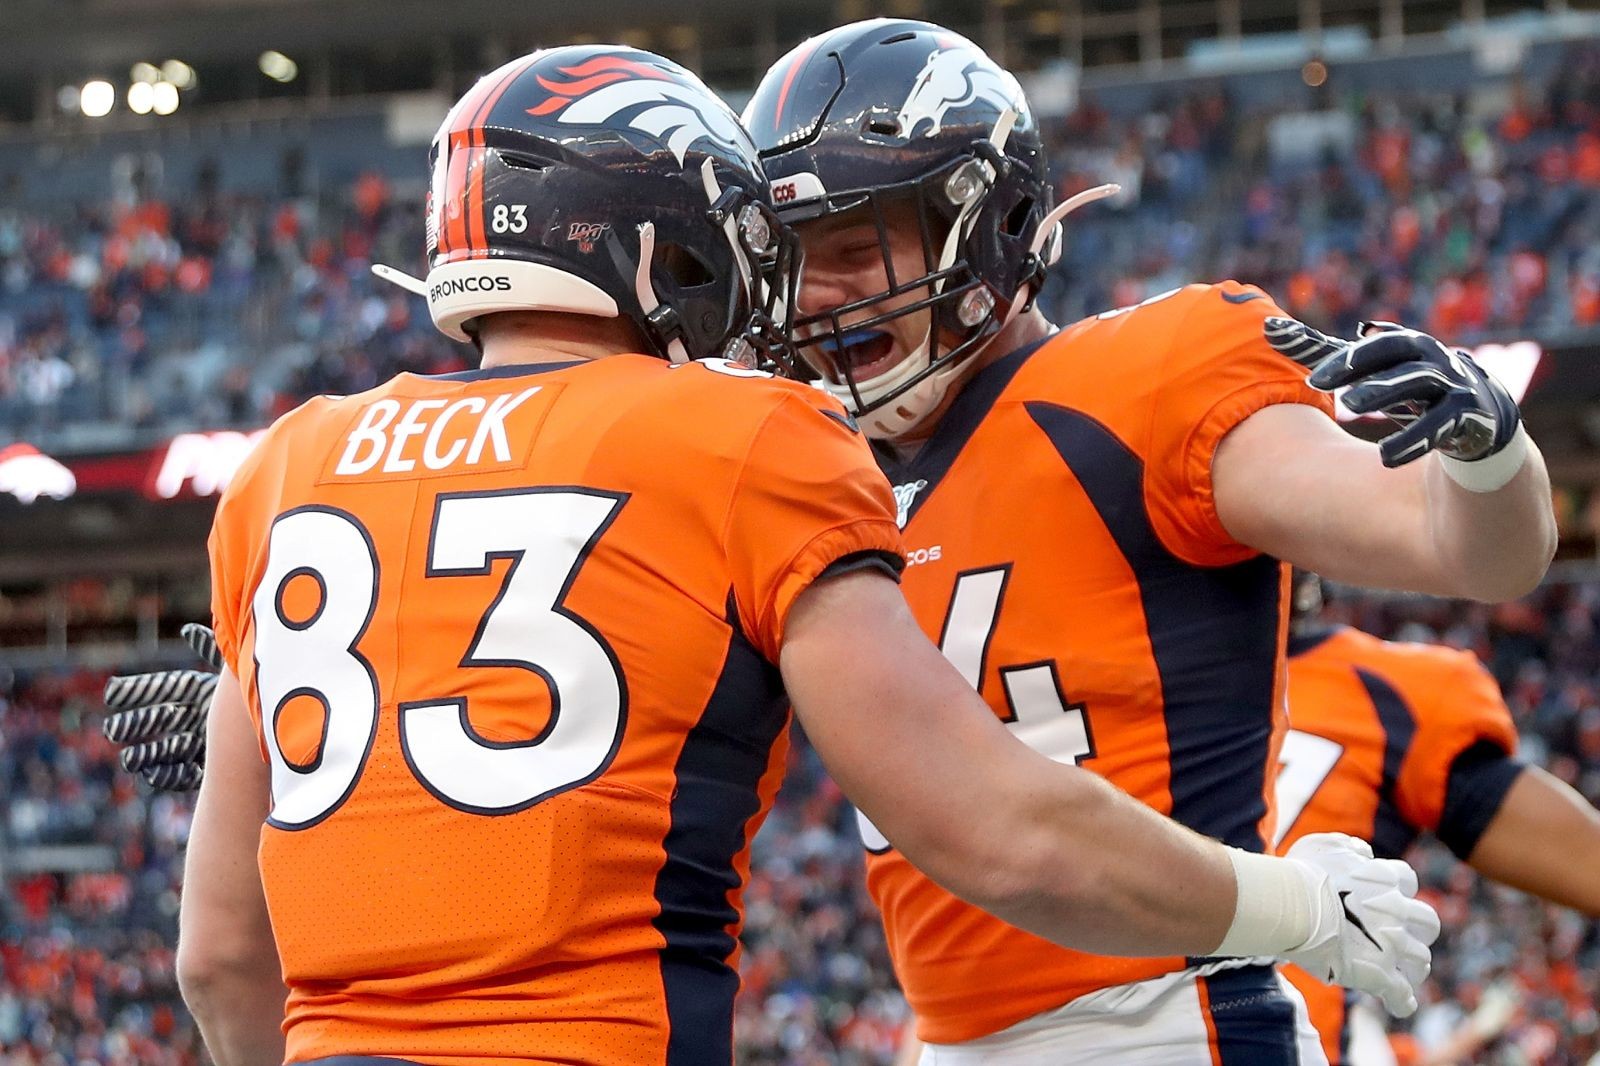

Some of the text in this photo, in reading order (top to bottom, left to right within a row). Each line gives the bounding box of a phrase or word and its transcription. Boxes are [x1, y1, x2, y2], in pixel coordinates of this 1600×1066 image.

[491, 204, 529, 234] 83
[430, 276, 512, 303] BRONCOS
[335, 386, 543, 476] BECK
[253, 485, 632, 831] 83
